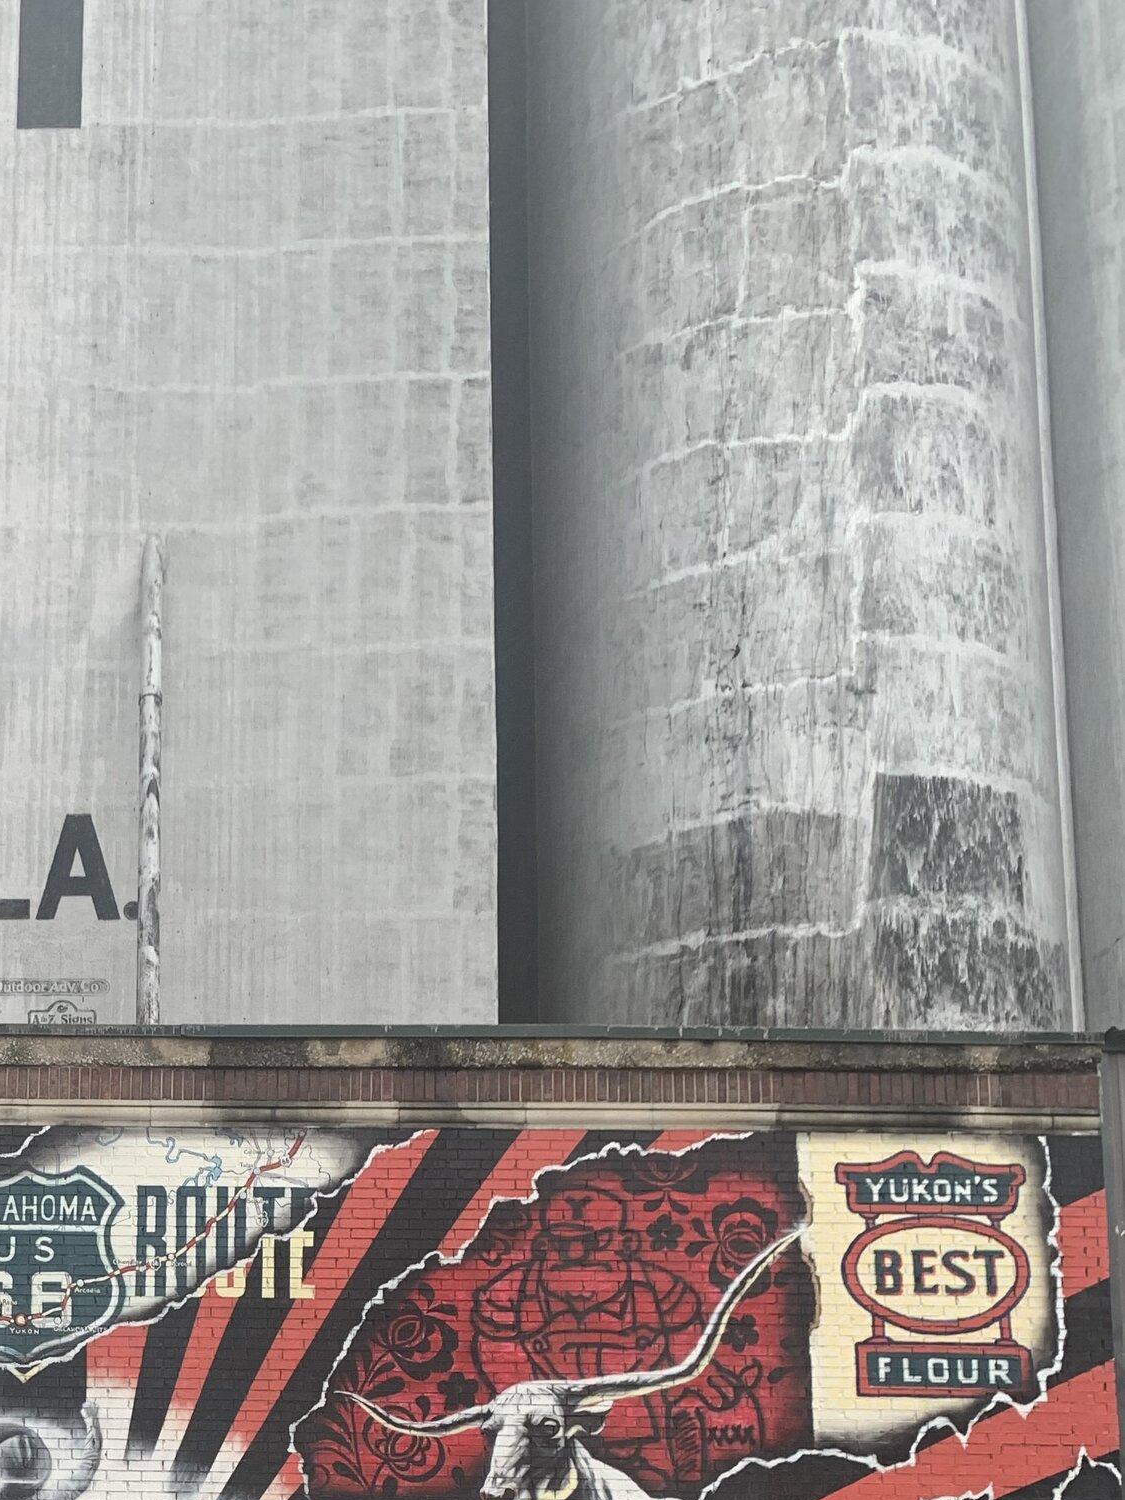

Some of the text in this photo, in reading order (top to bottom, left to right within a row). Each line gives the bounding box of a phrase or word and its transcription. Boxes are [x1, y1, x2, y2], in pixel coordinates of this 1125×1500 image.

[864, 1175, 1000, 1204] YUKON'S
[135, 1185, 319, 1300] ROUTE
[873, 1249, 1005, 1297] BEST
[74, 1286, 102, 1295] Arcadia
[877, 1356, 1014, 1385] FLOUR
